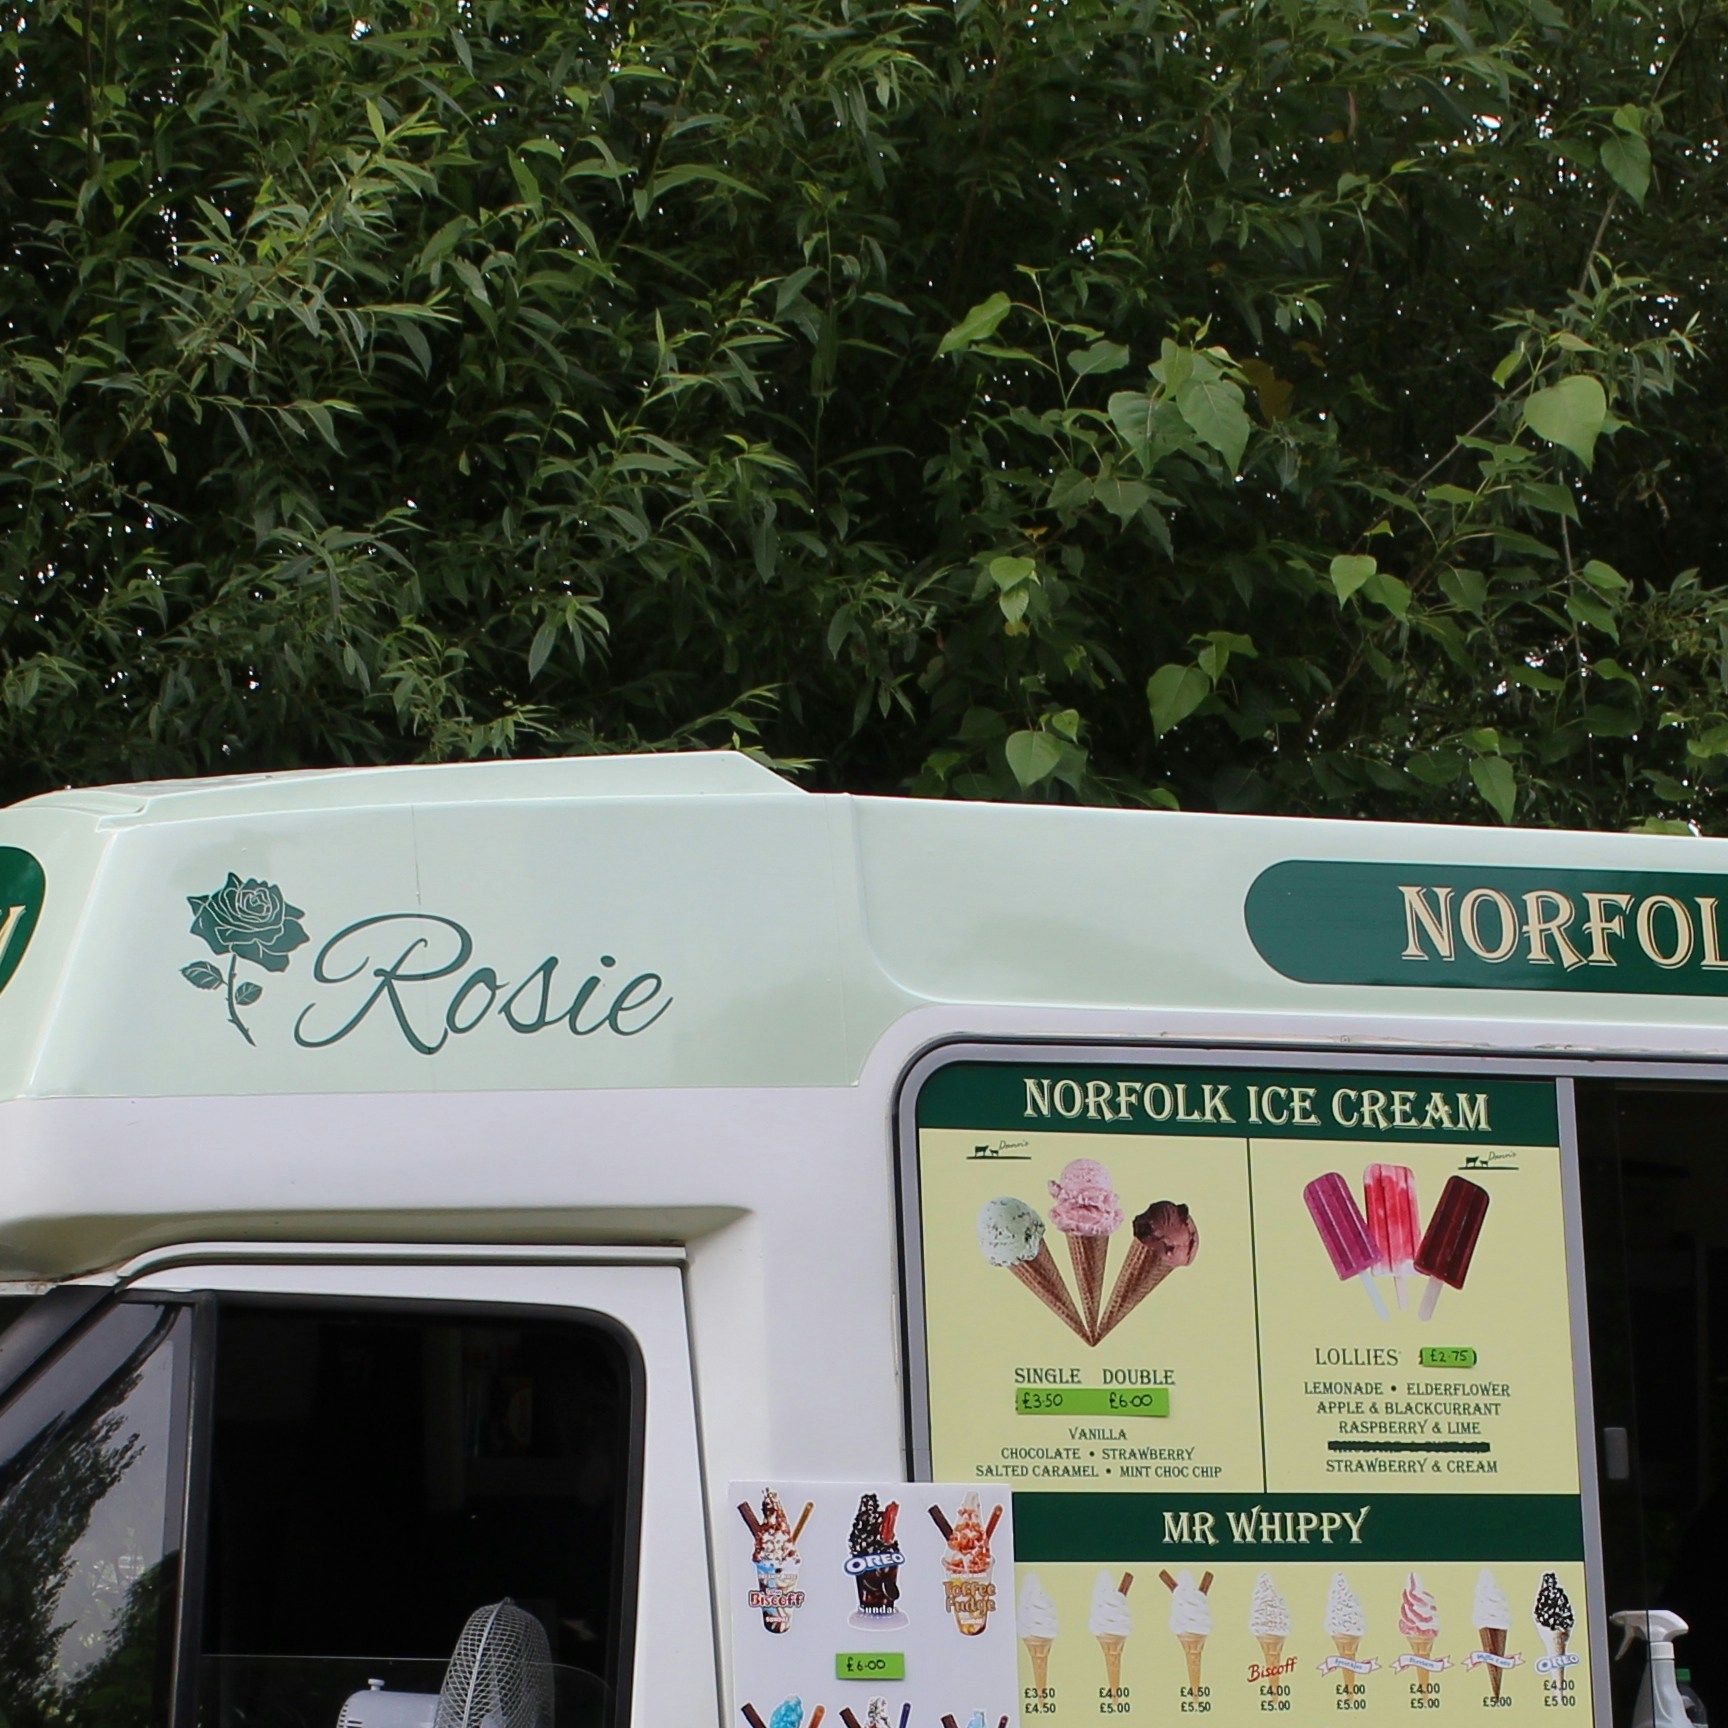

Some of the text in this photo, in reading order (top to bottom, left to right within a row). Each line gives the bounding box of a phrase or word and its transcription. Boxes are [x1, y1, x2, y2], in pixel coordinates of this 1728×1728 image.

[295, 912, 673, 1056] Rosie
[1023, 1078, 1492, 1132] NORFOLK ICE CREAM
[1315, 1348, 1399, 1366] LOLLIES
[1015, 1367, 1176, 1386] SINGLE DOUBLE
[1304, 1382, 1511, 1397] LEMONADE ELDERFLOWER
[1317, 1401, 1501, 1416] APPLE & BLACKCURRANT
[1068, 1427, 1128, 1440] VANILLA
[1339, 1419, 1481, 1435] RASPBERRY & LIME
[1001, 1446, 1195, 1461] CHOCOLATE STRAWBERRY
[976, 1465, 1223, 1478] SALTED CARAMEL MINT CHOC CHIP
[1326, 1458, 1498, 1473] STRAWBERRY & CREAM
[1162, 1504, 1371, 1546] MR WHIPPY
[845, 1553, 904, 1575] OREO
[943, 1581, 996, 1597] Toffee
[750, 1591, 805, 1607] Biscoff
[946, 1598, 996, 1614] Fudge
[1247, 1657, 1298, 1683] Biscoff
[1536, 1655, 1579, 1672] OREO
[1259, 1685, 1291, 1697] £4.00
[1336, 1684, 1366, 1696] £4.00
[1409, 1683, 1441, 1695] £4.00
[1543, 1679, 1575, 1691] £4.00
[1024, 1687, 1056, 1699] £3.50
[1098, 1687, 1130, 1698] £4.00
[1180, 1686, 1211, 1698] £4.50
[1099, 1702, 1131, 1713] £5.00
[1180, 1701, 1212, 1713] £5.50
[1260, 1700, 1291, 1712] £5.00
[1336, 1698, 1367, 1711] £5.00
[1410, 1698, 1441, 1710] £5.00
[1482, 1696, 1513, 1708] £5.00
[1544, 1695, 1576, 1707] £5.00
[1025, 1702, 1057, 1714] £4.50
